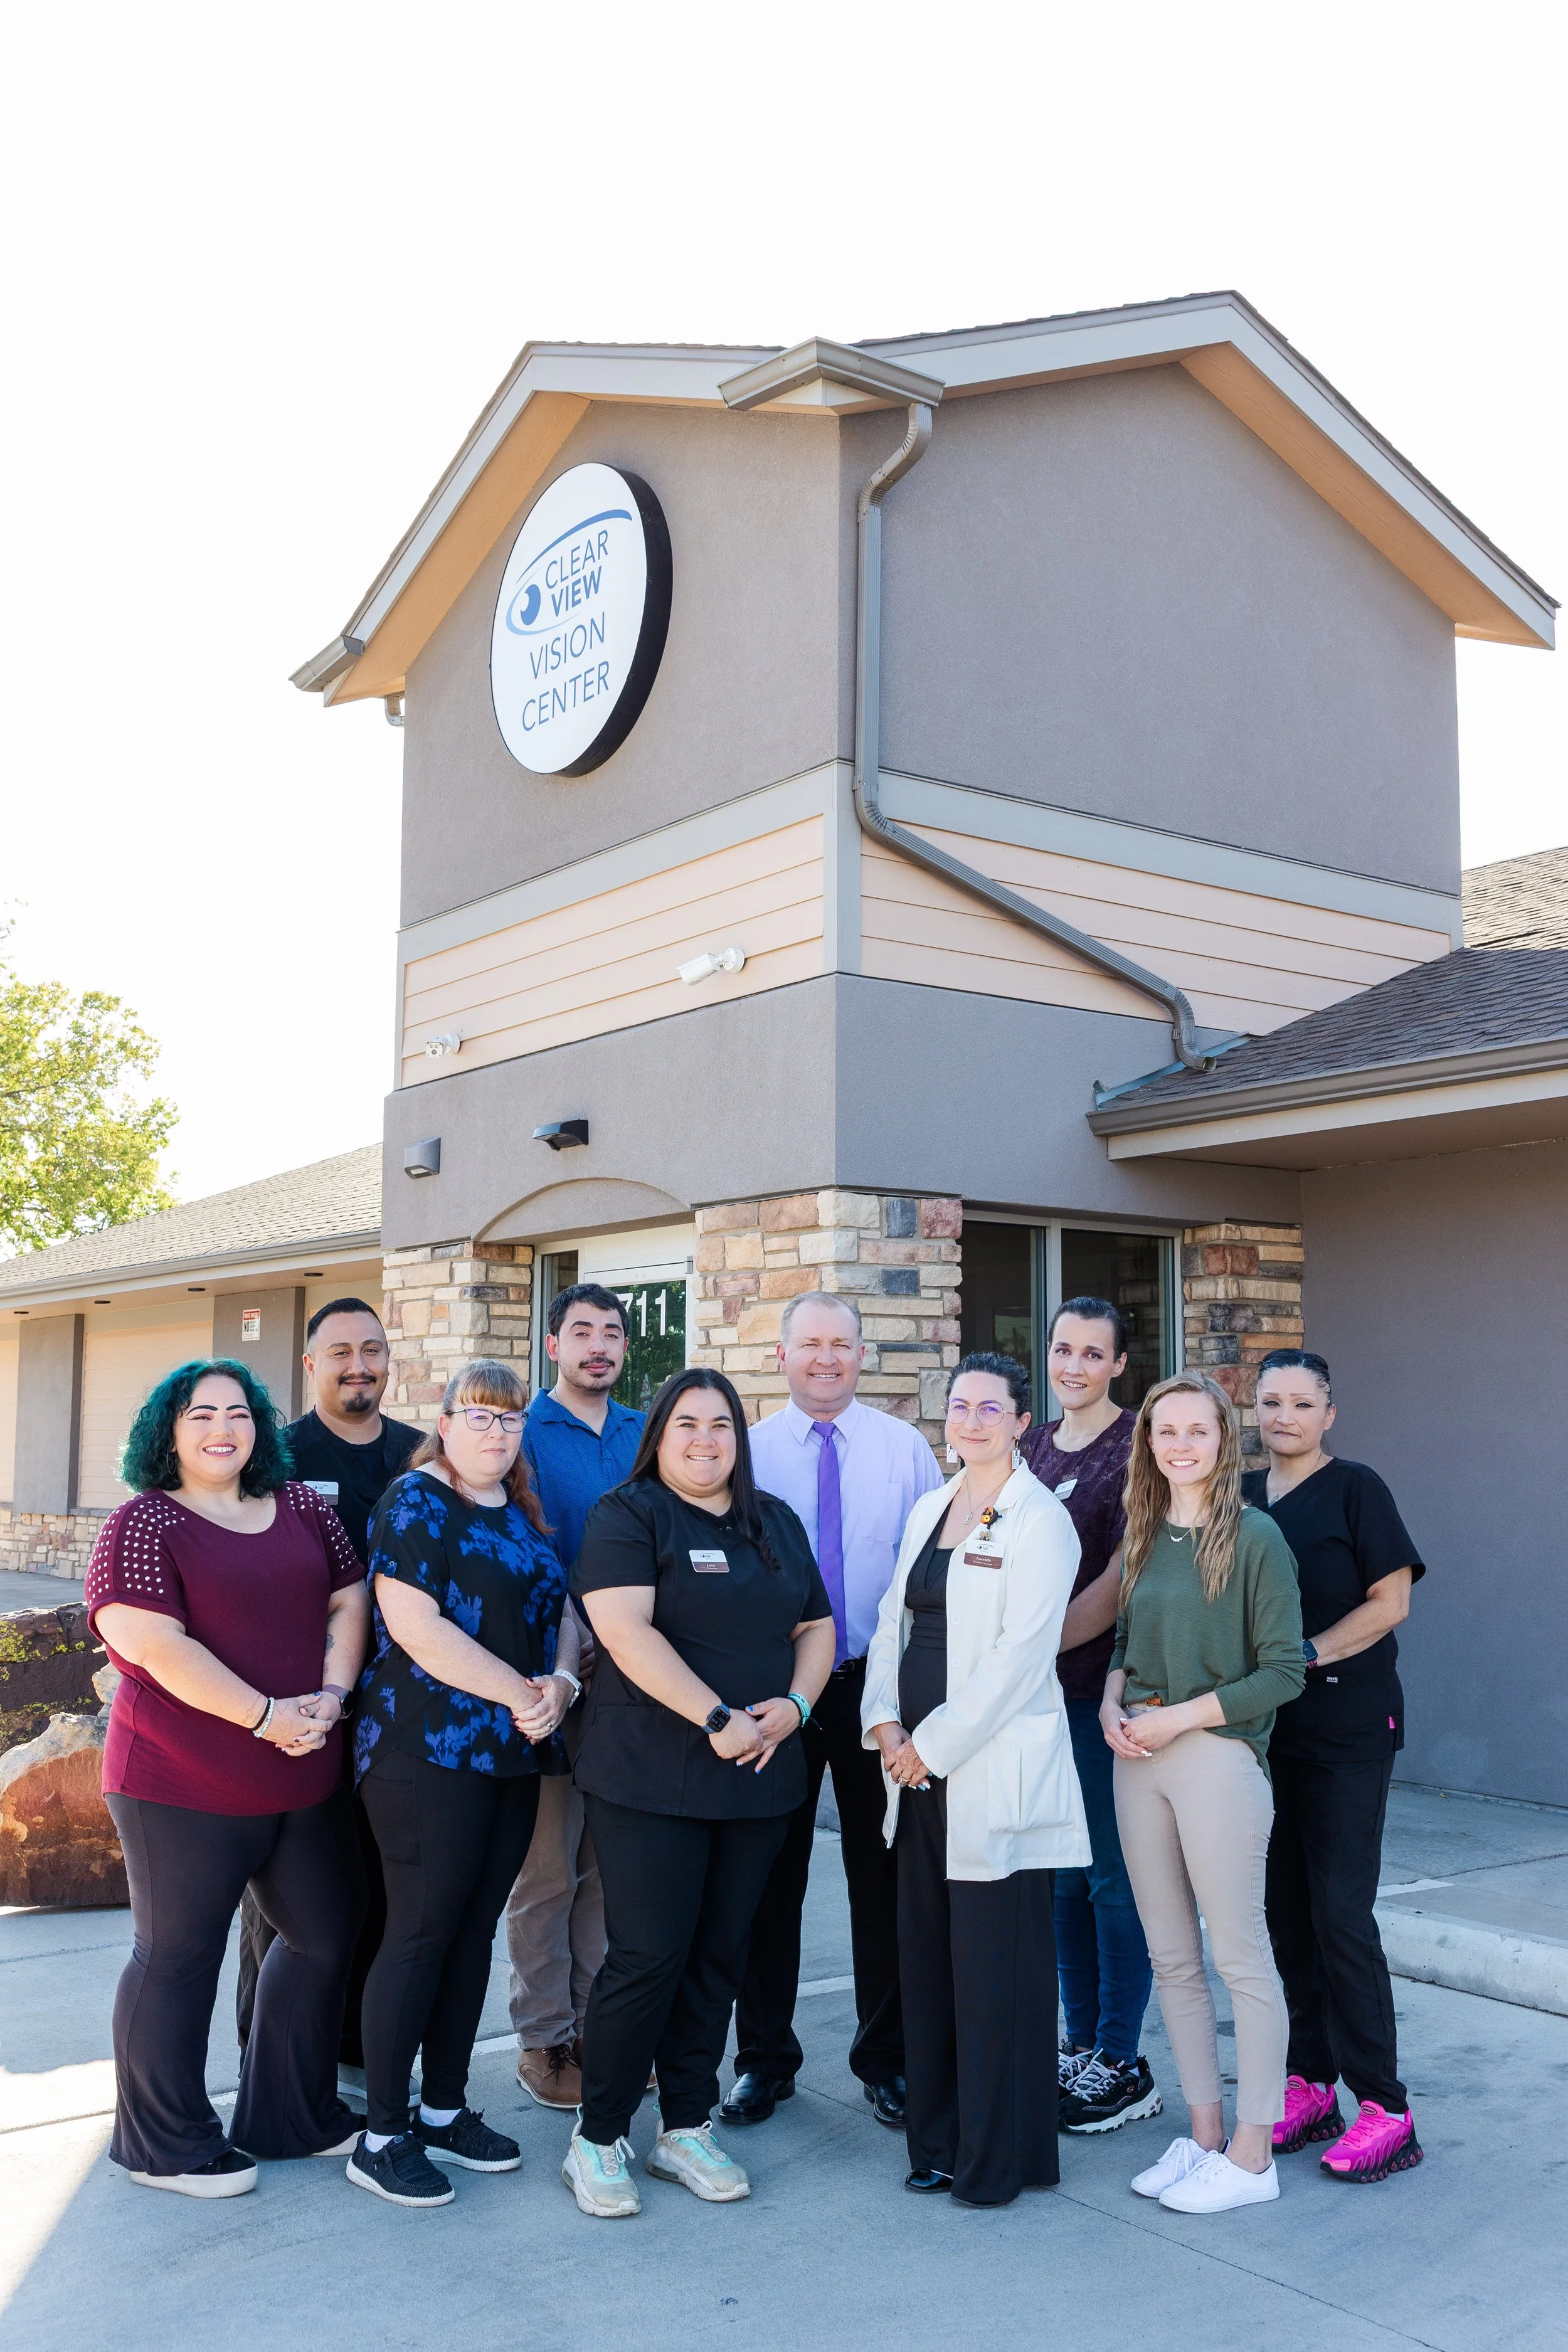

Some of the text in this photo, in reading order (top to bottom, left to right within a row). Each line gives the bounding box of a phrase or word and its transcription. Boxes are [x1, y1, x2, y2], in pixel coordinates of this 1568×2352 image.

[545, 529, 608, 590] CLEAR
[551, 566, 603, 617] VIEW
[530, 612, 605, 679] VISION
[522, 660, 610, 731] CENTER
